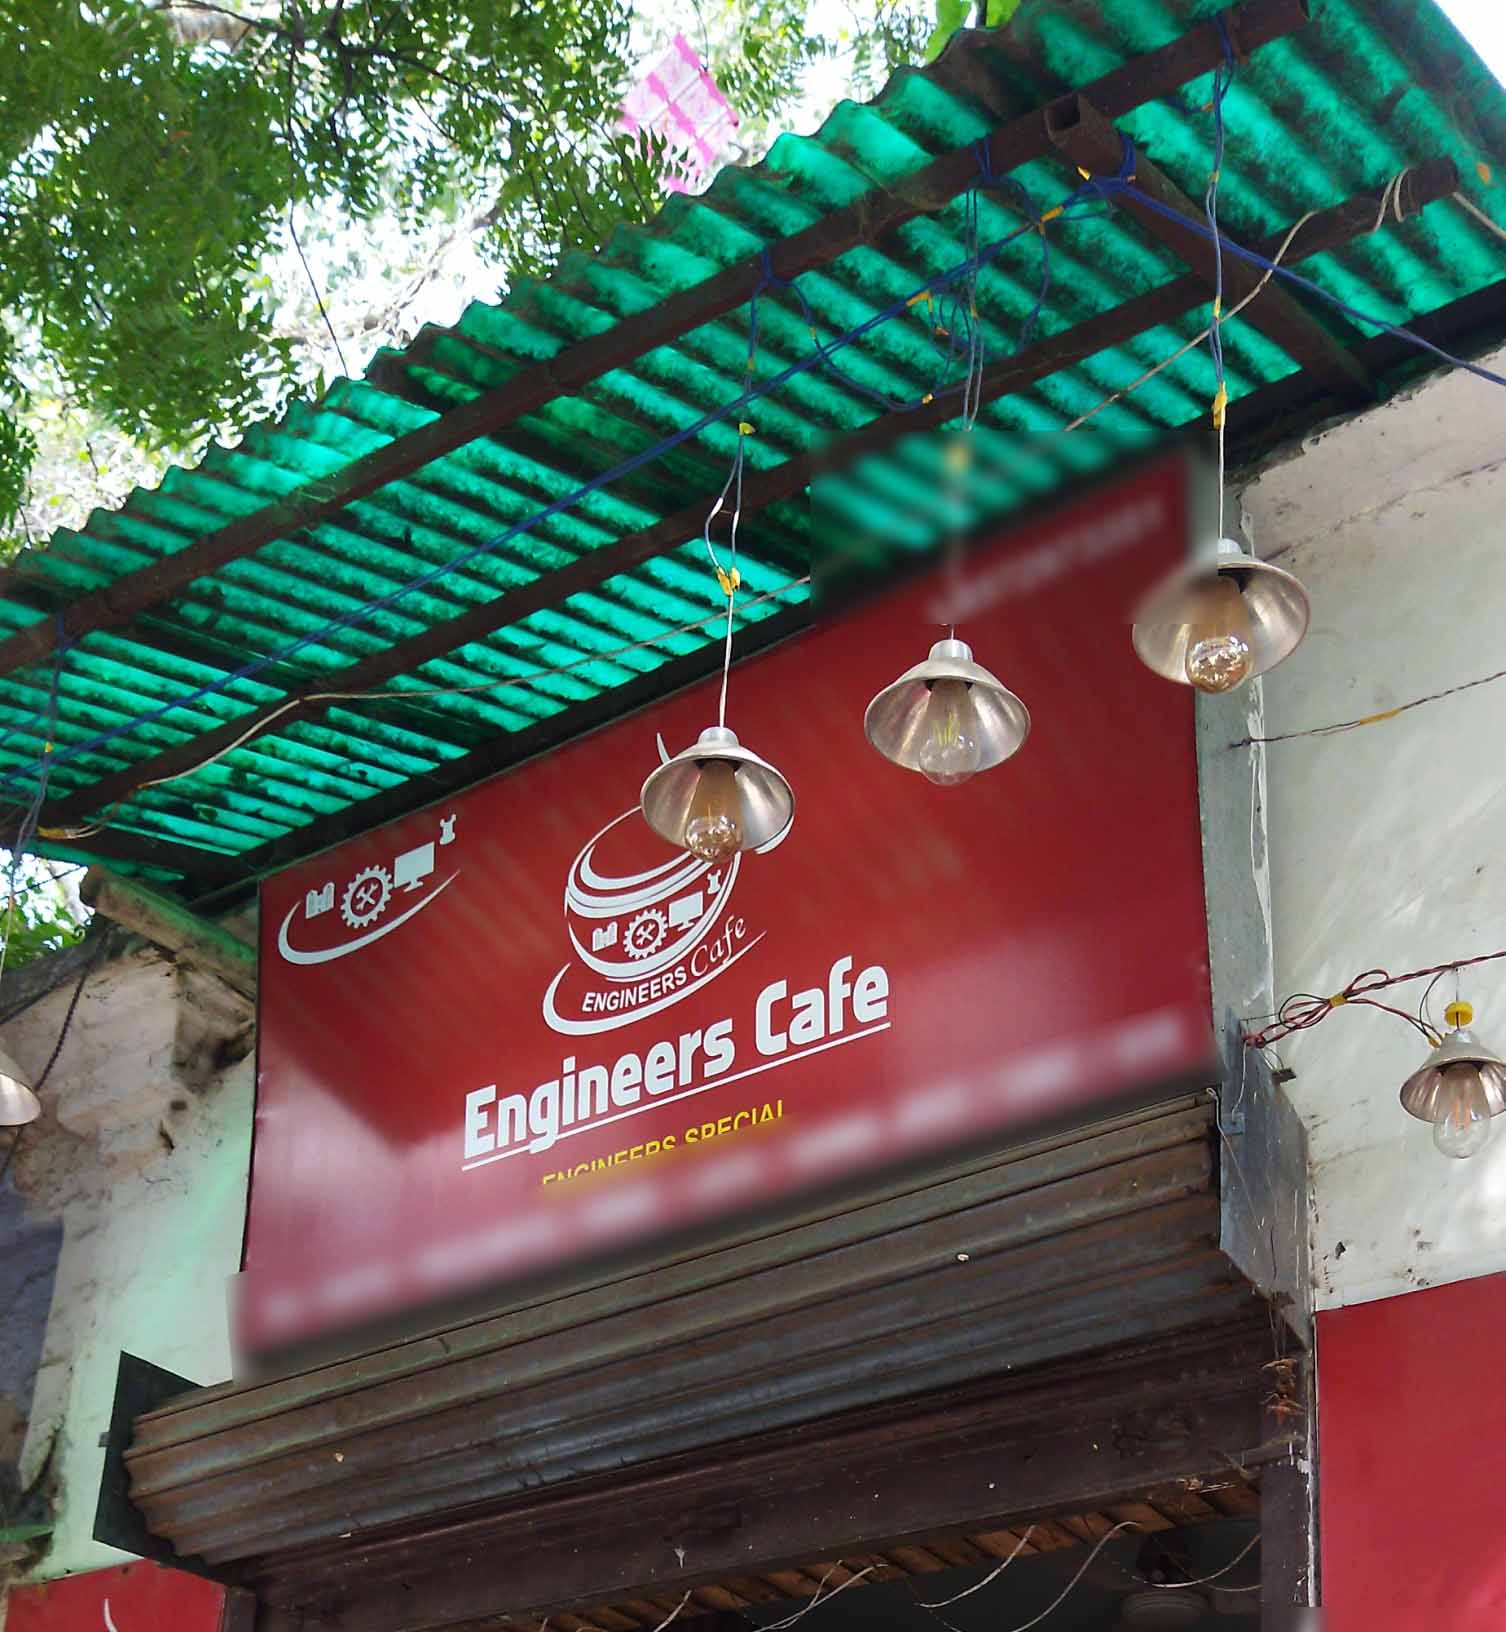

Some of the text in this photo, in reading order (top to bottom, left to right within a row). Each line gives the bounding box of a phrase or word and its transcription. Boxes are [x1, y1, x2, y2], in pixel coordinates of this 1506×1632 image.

[581, 915, 747, 1013] ENGINEERS Cafe
[464, 956, 889, 1158] Engineers Cafe
